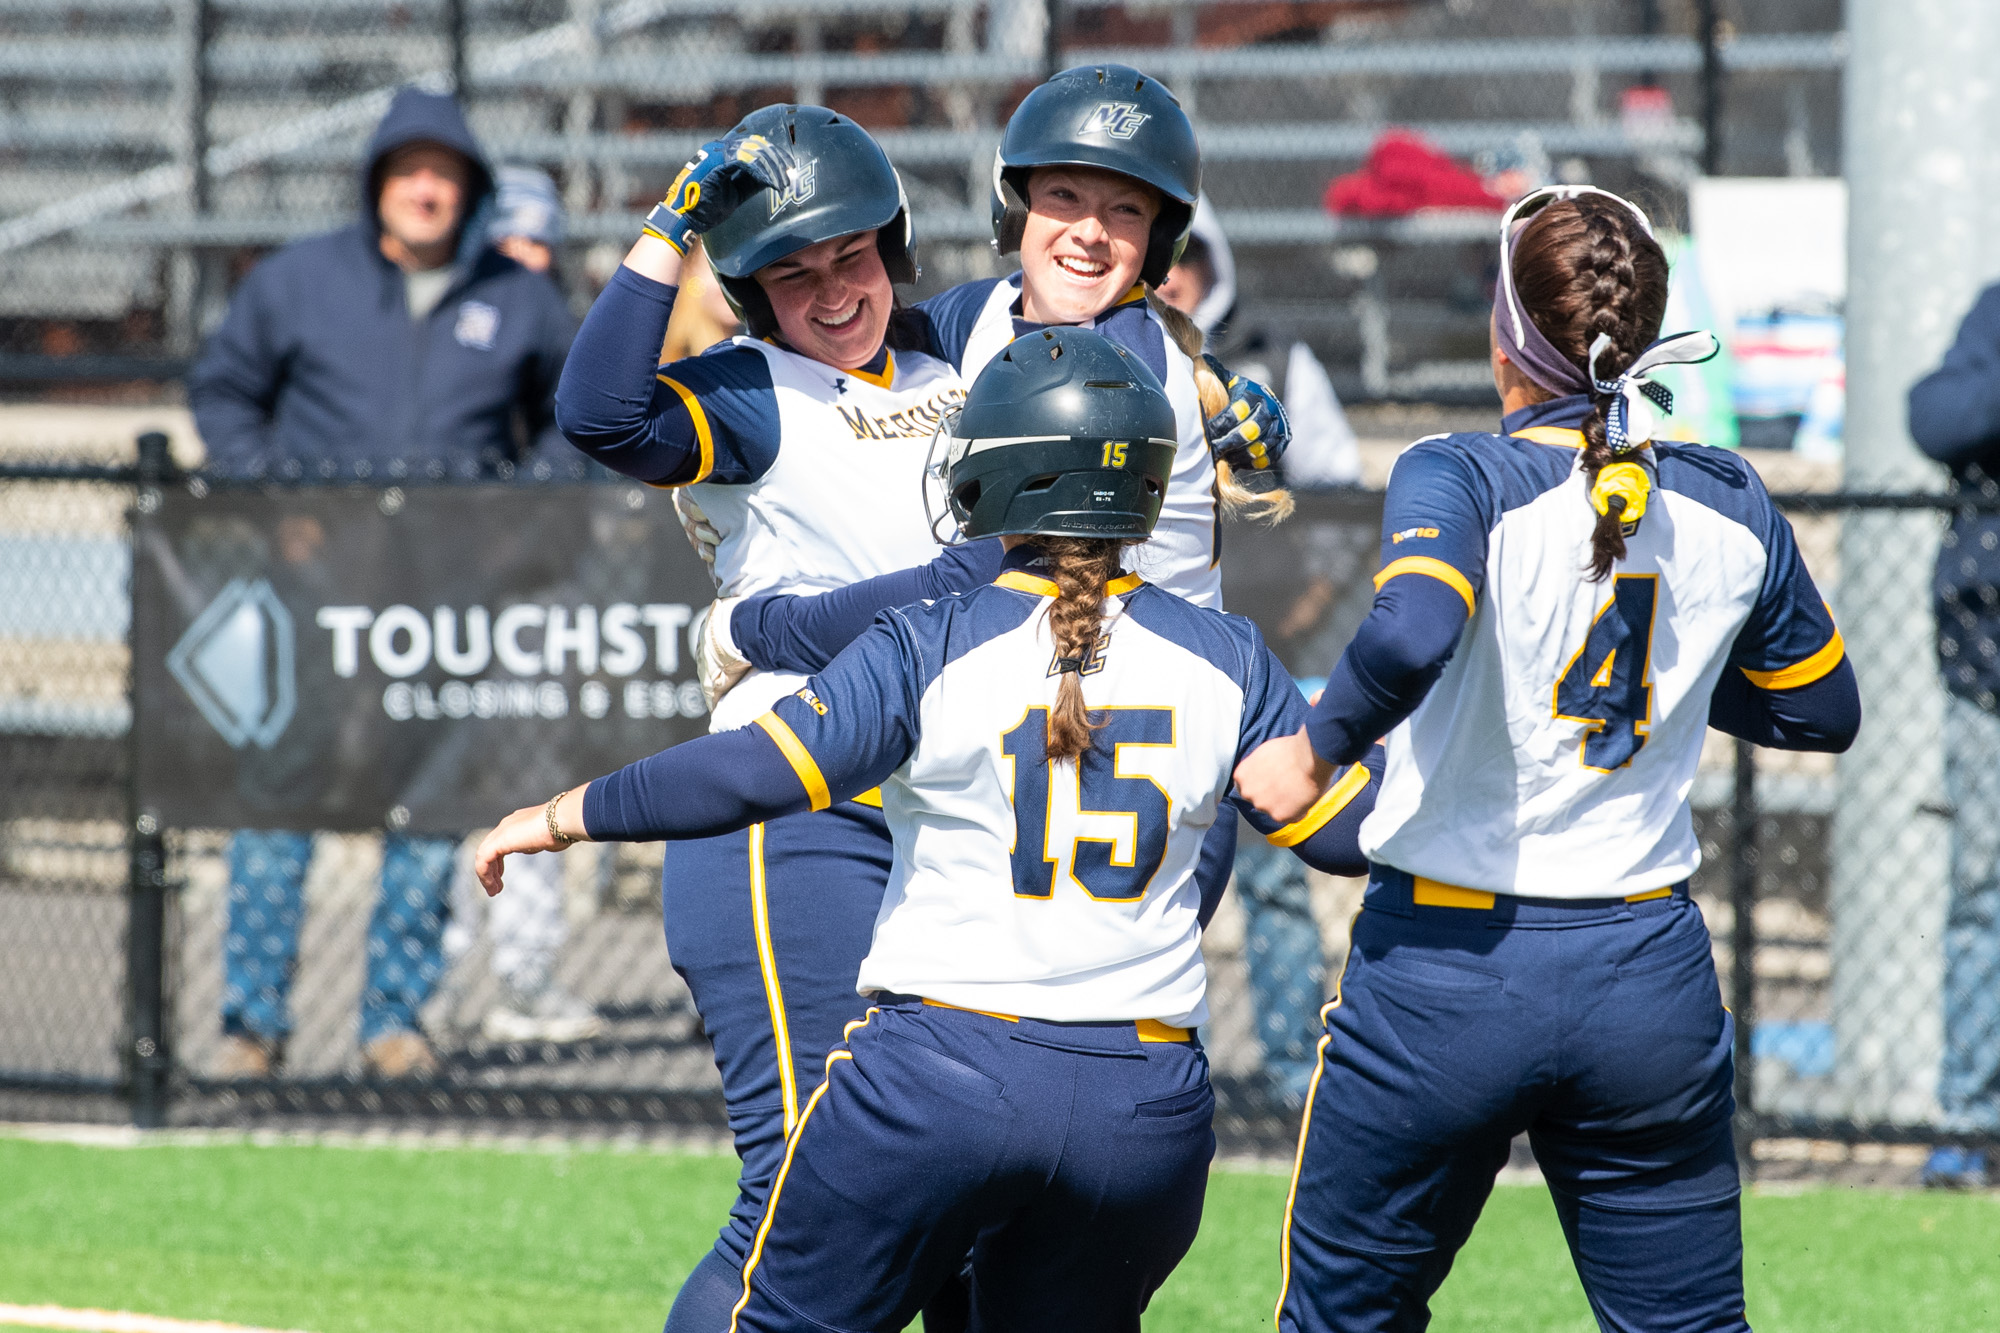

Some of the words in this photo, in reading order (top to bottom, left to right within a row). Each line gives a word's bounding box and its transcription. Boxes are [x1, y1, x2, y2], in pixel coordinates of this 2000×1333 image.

[1078, 102, 1151, 139] MC
[1101, 441, 1129, 470] 15
[315, 602, 709, 679] TOUCHST
[383, 679, 569, 721] CLOSING
[580, 680, 609, 719] &
[1552, 571, 1661, 775] 4
[1000, 704, 1176, 903] 15
